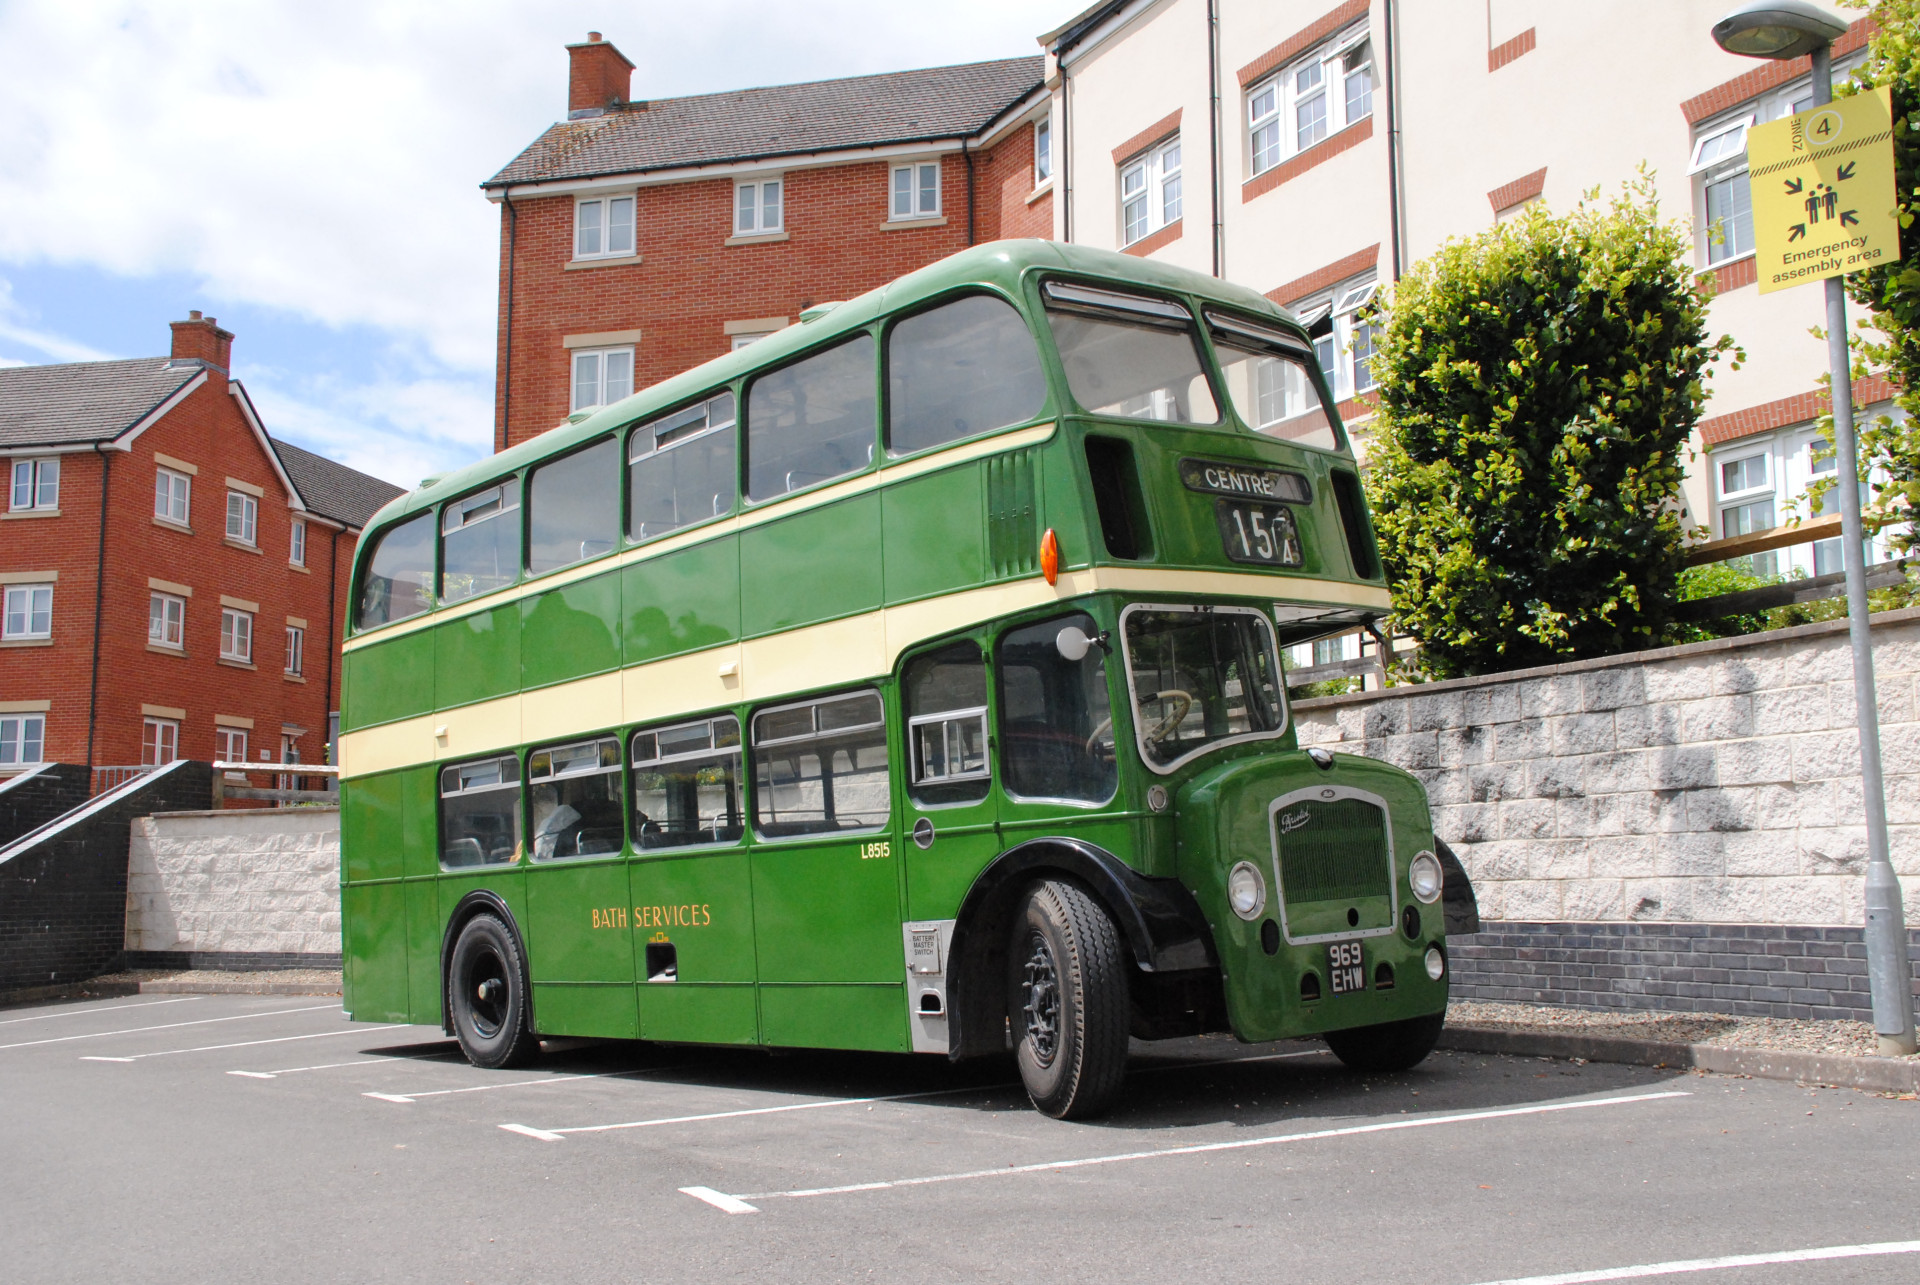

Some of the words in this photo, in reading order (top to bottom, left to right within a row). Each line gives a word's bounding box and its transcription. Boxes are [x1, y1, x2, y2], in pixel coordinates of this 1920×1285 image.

[1790, 118, 1802, 153] ZONE
[1816, 117, 1831, 136] 4
[1782, 235, 1868, 265] Emergency
[1772, 257, 1842, 284] assembly
[1847, 248, 1881, 265] area
[1205, 468, 1274, 496] CENTRE
[861, 842, 890, 859] L8515
[592, 907, 627, 929] BATH
[634, 904, 711, 928] SERVICES
[913, 941, 934, 949] MASTER
[1330, 942, 1362, 967] 969
[1331, 966, 1363, 992] EHW
